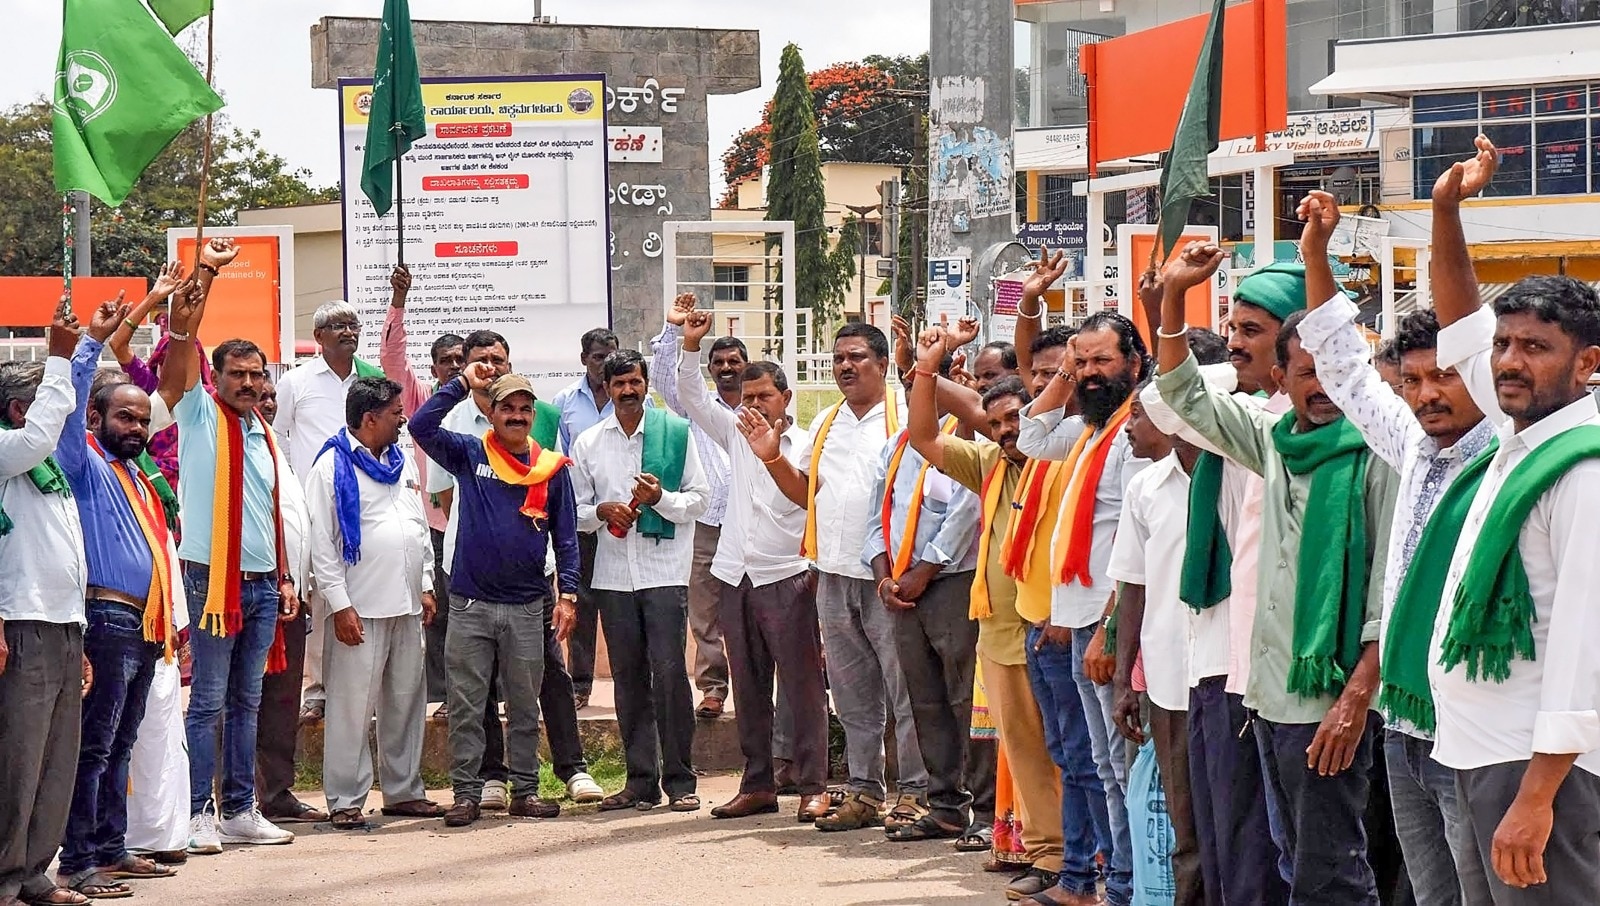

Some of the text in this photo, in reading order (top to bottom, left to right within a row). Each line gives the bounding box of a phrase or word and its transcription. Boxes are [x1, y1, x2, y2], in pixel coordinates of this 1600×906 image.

[498, 104, 563, 118] ಚಿಕ್ಕಮಗಳೂರು
[440, 124, 506, 137] ಸಾರ್ವಜನಿಕ ಪ್ರಕಟಣೆ
[609, 134, 647, 152] ಹಣೆ
[1236, 142, 1283, 154] LUKY
[1286, 140, 1324, 151] Vision
[1322, 137, 1363, 150] Opticals
[1027, 236, 1055, 245] DIGITAL
[1057, 235, 1084, 245] STUDIO
[454, 244, 498, 254] ಸೂಚನೆಗಳು
[255, 270, 266, 278] by
